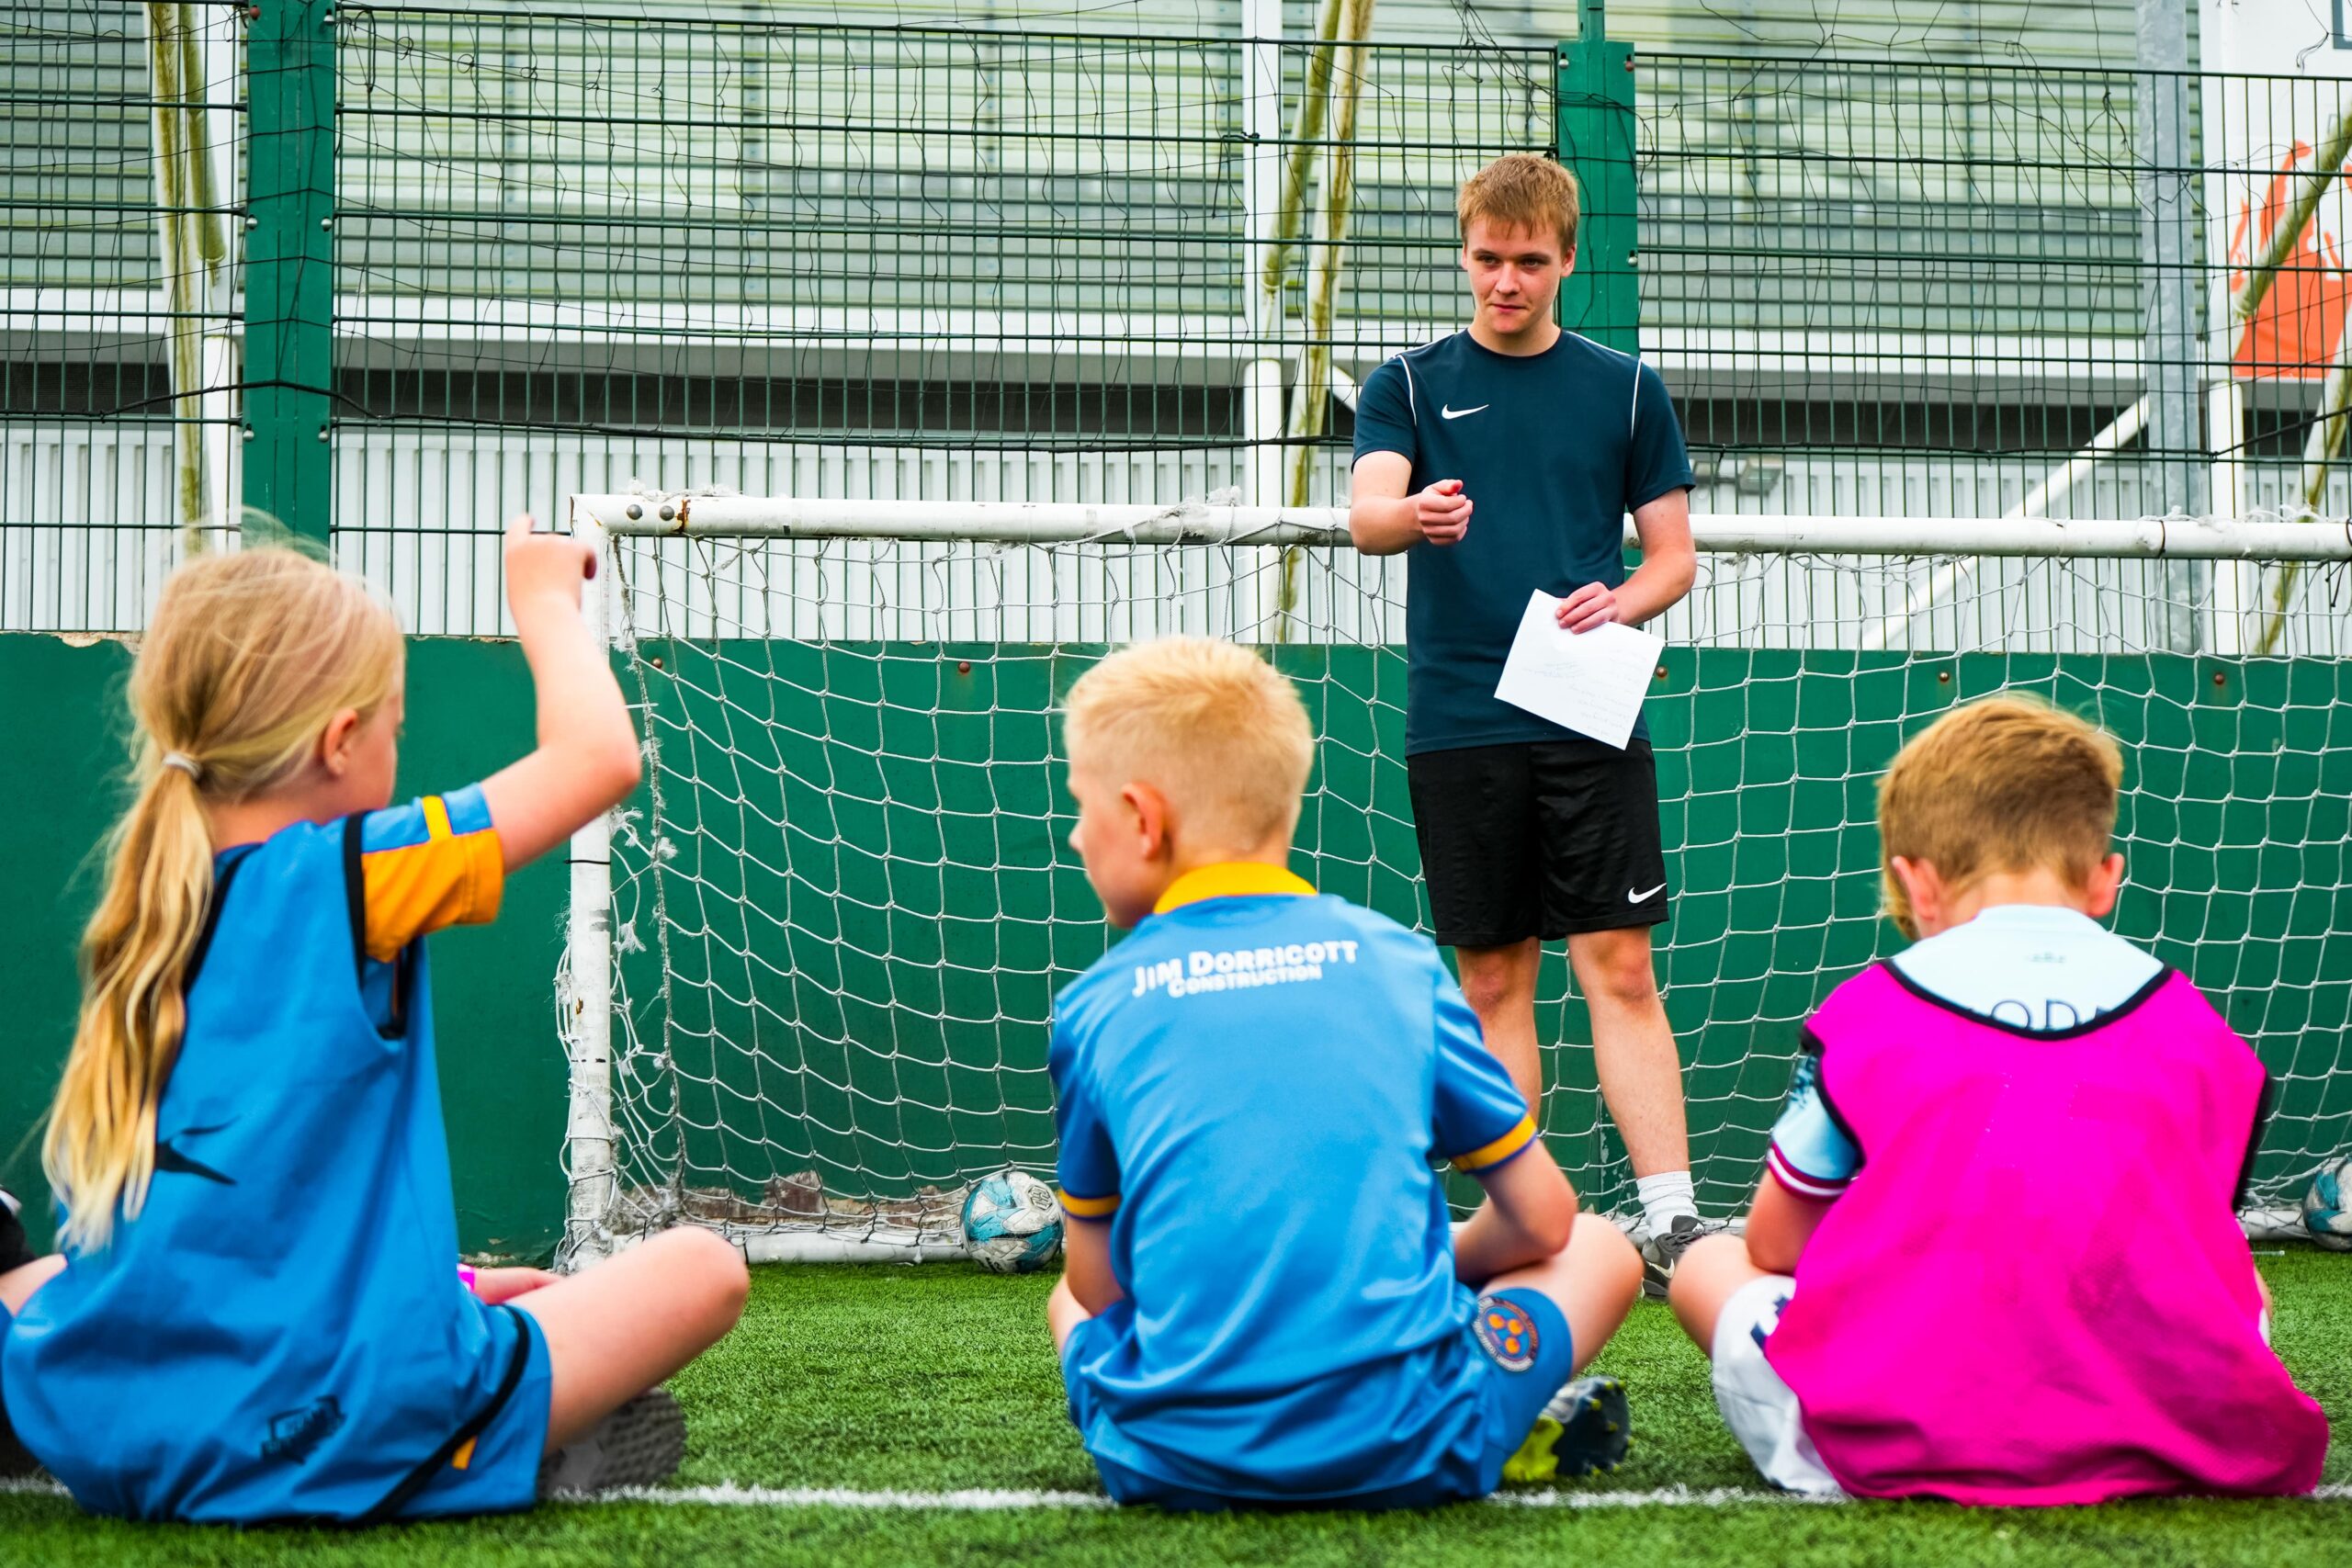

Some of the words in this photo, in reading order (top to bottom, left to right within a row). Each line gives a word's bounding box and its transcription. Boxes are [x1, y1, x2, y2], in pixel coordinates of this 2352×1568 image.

[1132, 958, 1182, 998] JIM
[1189, 941, 1358, 976] DORRICOTT
[1168, 964, 1322, 998] CONSTRUCTION
